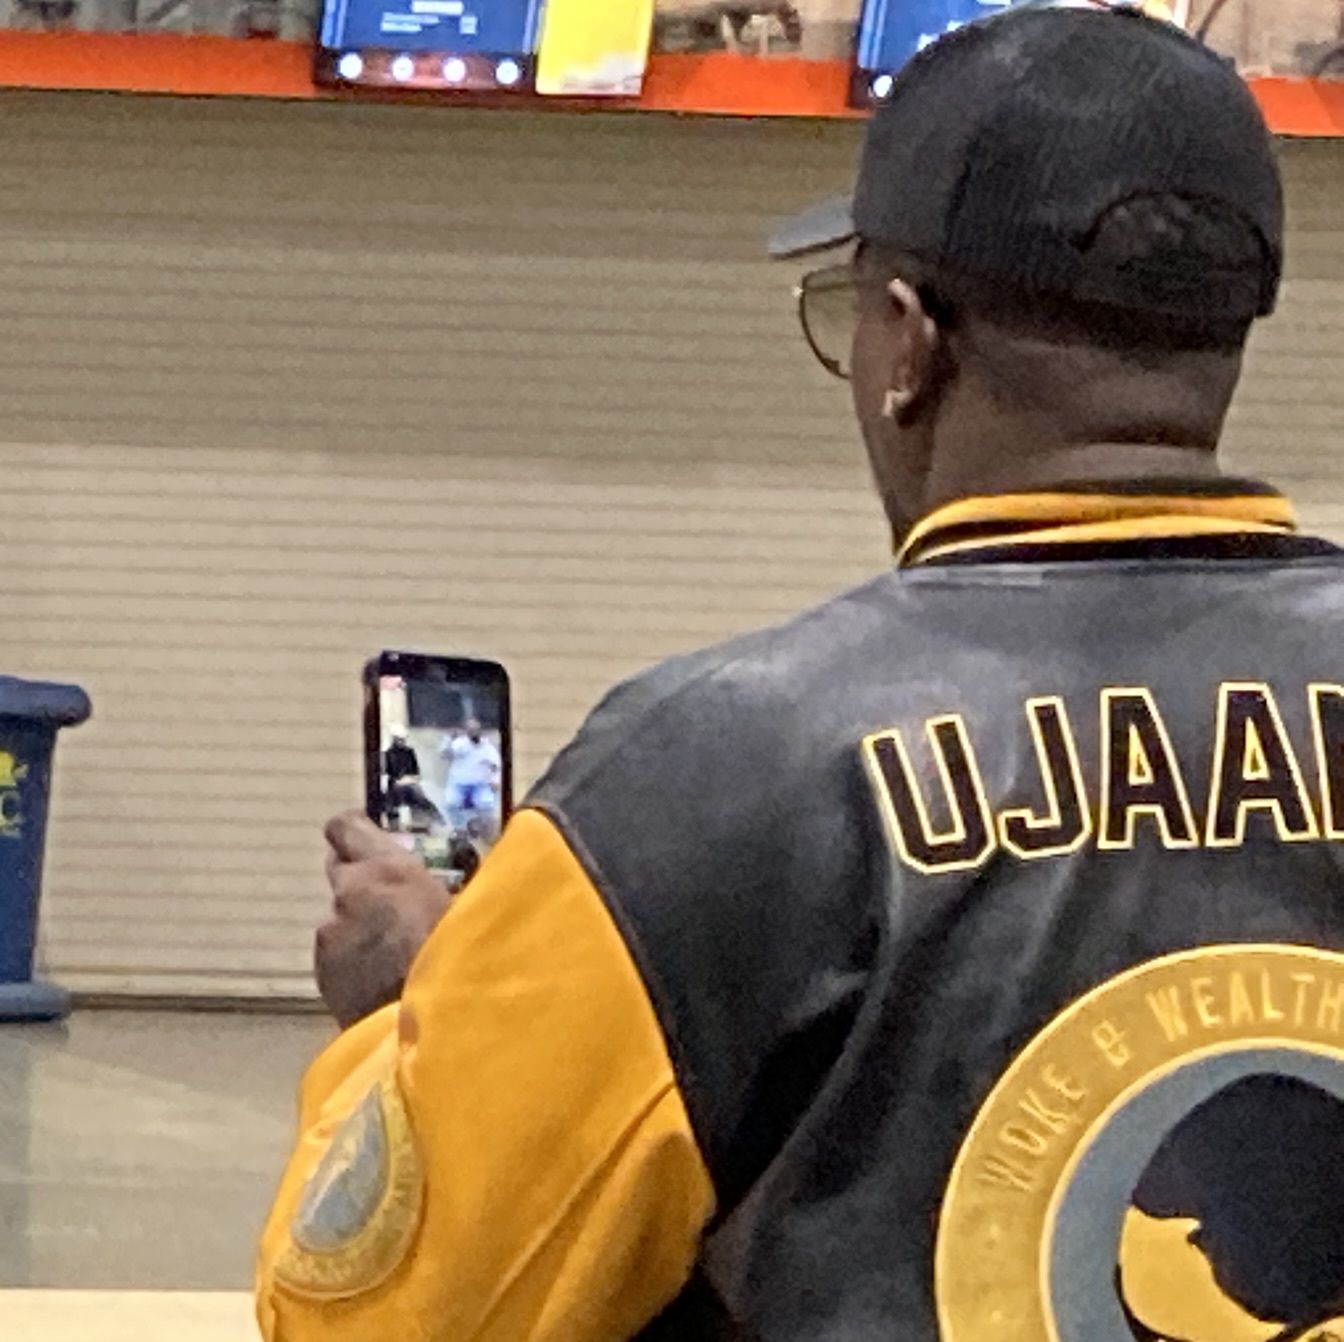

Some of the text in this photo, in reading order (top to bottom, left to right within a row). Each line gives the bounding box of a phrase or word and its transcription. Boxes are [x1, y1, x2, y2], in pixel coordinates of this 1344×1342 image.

[977, 967, 1344, 1193] WOKE & WEALTH
